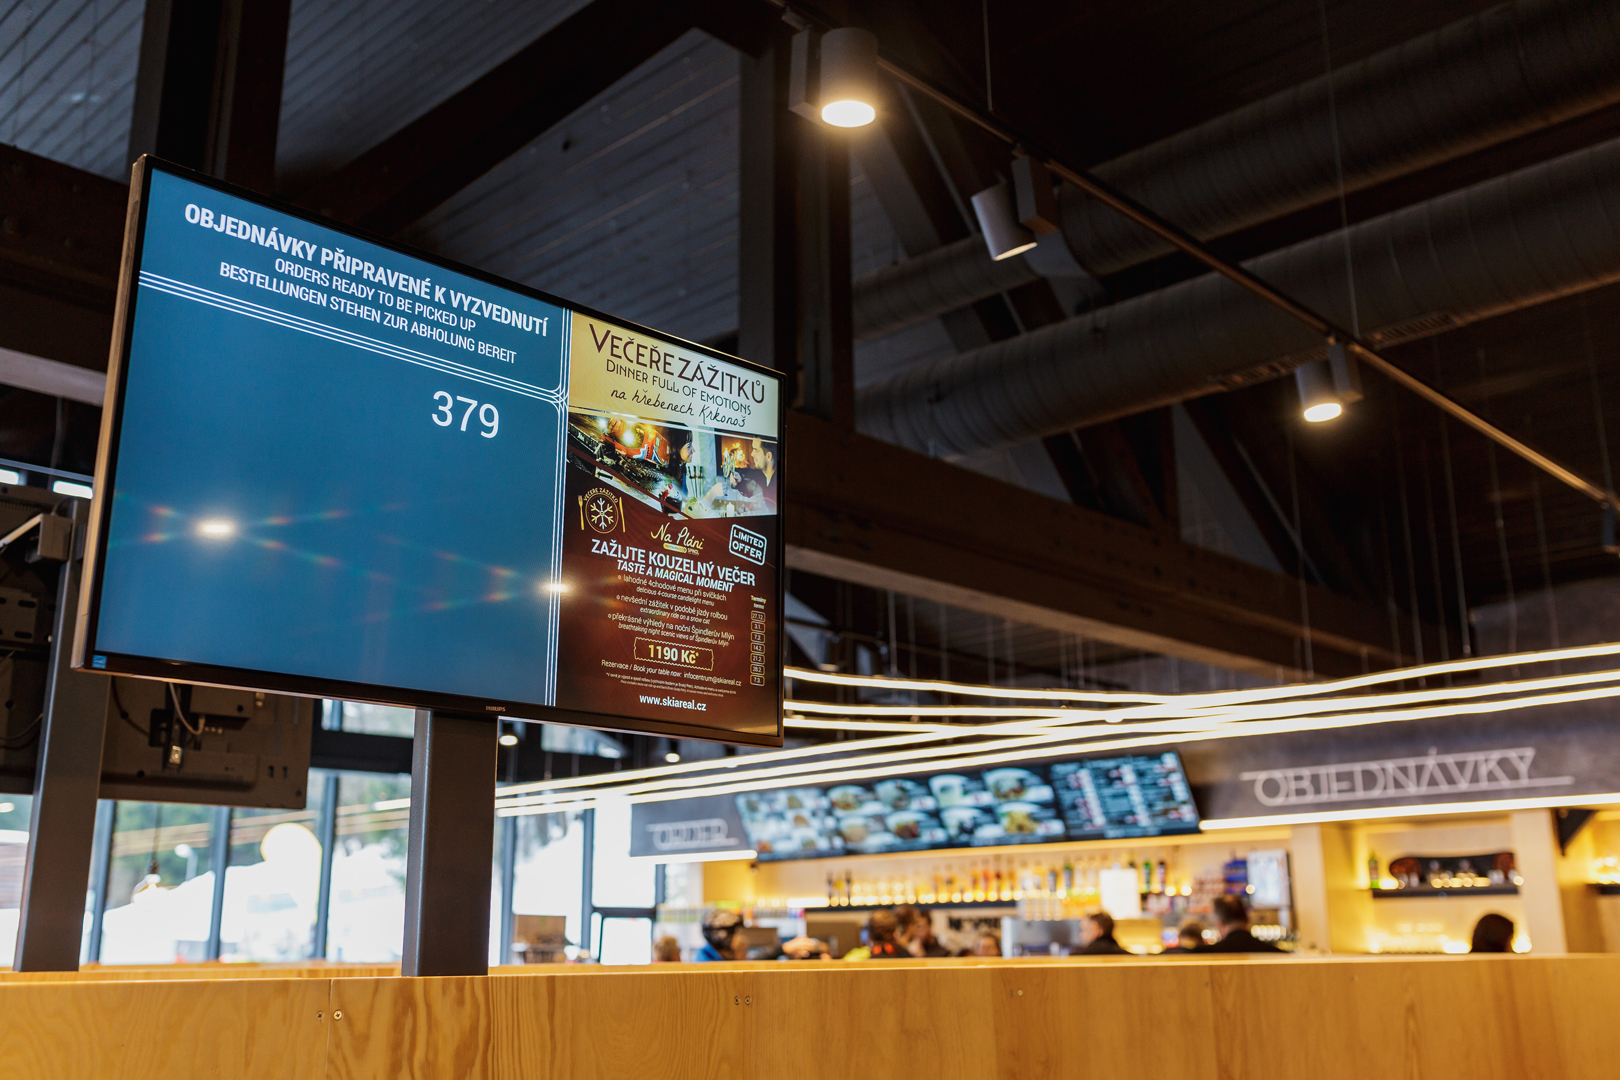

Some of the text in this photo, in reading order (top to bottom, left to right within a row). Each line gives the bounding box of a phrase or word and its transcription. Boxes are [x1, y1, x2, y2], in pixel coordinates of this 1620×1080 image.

[185, 203, 549, 337] OBJEDNÁVKY PŘIPRAVENÉ K VYZVEDNUTÍ
[220, 262, 517, 364] BESTELLUNGEN STEHEN ZUR ABHOLUNG BEREIT
[275, 258, 476, 332] ORDERS READY TO BE PICKED UP
[606, 359, 752, 416] DINNER FULL OF EMOTIONS
[431, 390, 500, 439] 379
[611, 388, 746, 427] na hřebenech Krkonoš
[650, 522, 672, 543] Na
[676, 526, 705, 549] Pláni
[732, 530, 764, 560] LIMITED OFFER
[591, 538, 645, 563] ZAŽIJTE
[648, 551, 715, 577] KOUZELNÝ
[717, 565, 755, 586] VEČER
[617, 560, 734, 593] TASTE A MAGICAL MOMENT
[620, 594, 647, 606] nevšední
[623, 574, 647, 586] lahodné
[677, 586, 693, 595] menu
[601, 659, 629, 670] Rezervace
[633, 664, 646, 673] Book
[648, 644, 678, 661] 1190
[639, 694, 707, 711] www.skiareal.cz
[1253, 745, 1537, 807] OBJEDNÁVKY
